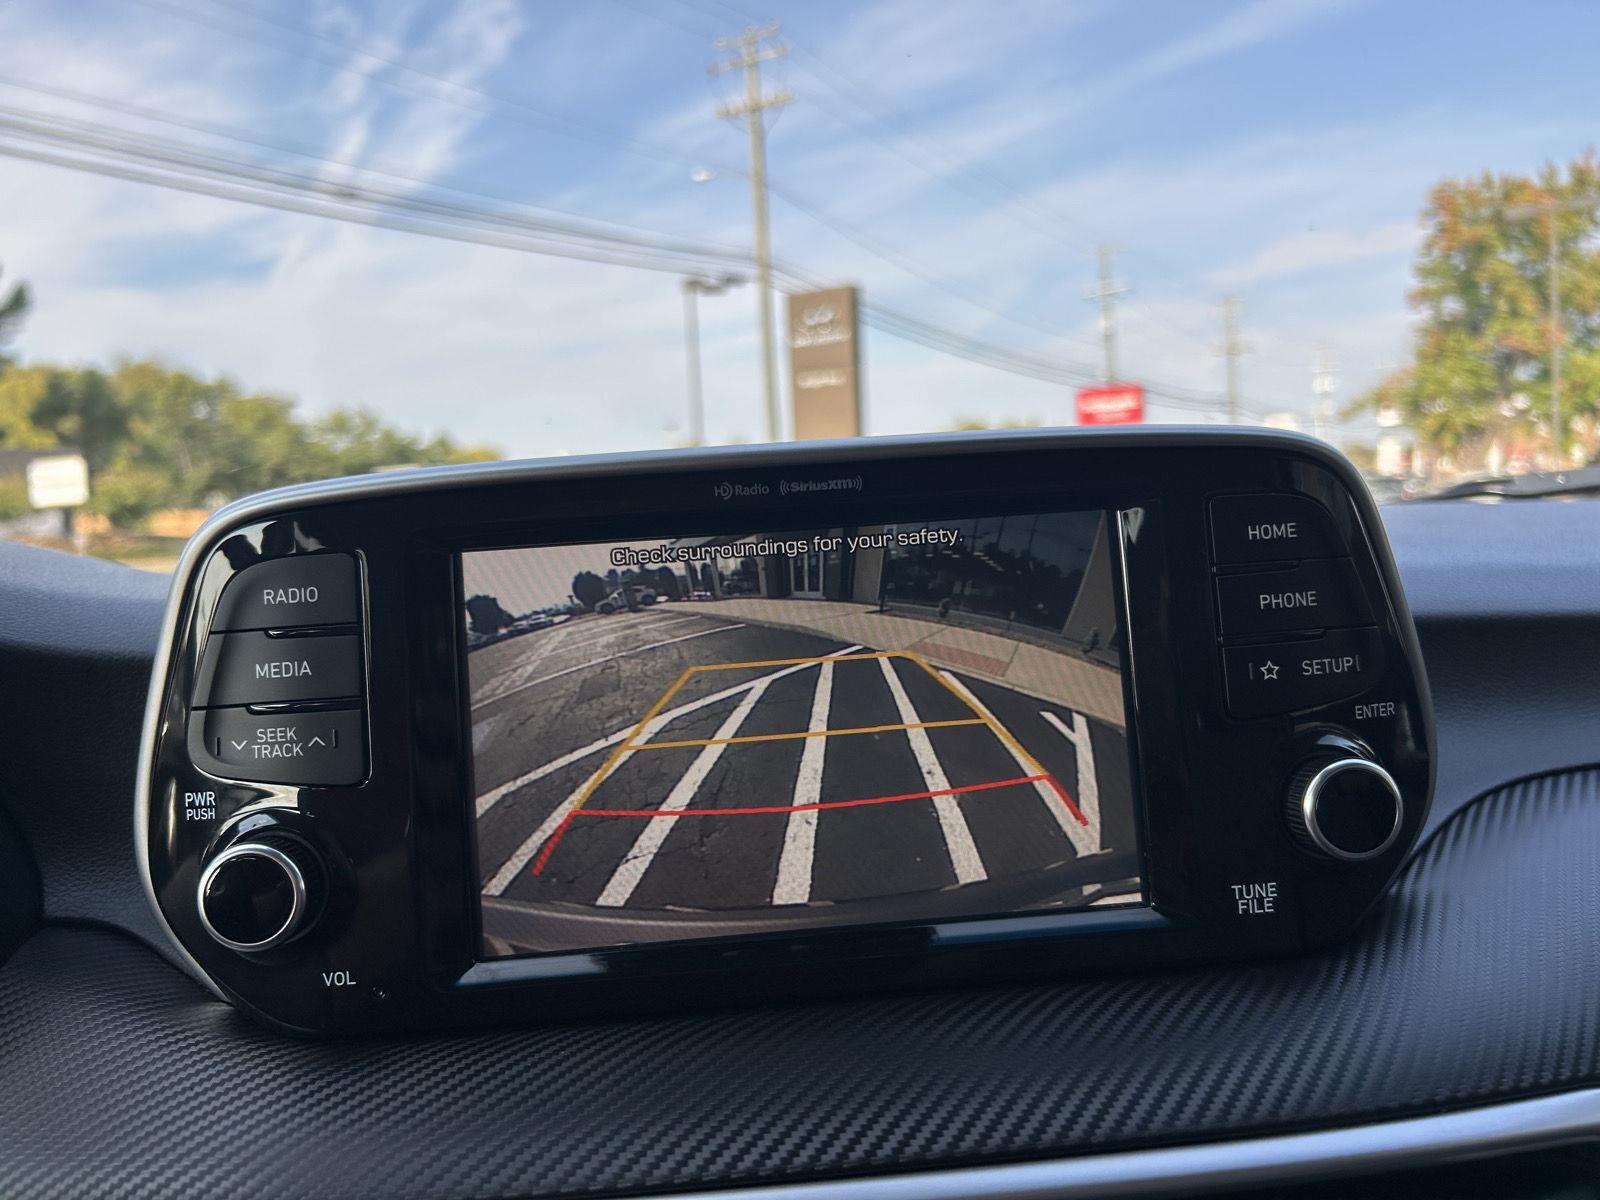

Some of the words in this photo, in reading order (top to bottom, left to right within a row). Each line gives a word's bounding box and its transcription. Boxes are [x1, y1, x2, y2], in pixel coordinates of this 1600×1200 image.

[735, 483, 770, 497] Radio
[1247, 522, 1298, 541] HOME
[611, 545, 674, 565] Check
[678, 538, 808, 560] surroundings
[813, 536, 842, 552] for
[847, 533, 893, 553] your
[898, 528, 963, 546] safety.
[263, 586, 319, 605] RADIO
[1259, 590, 1318, 610] PHONE
[255, 660, 312, 679] MEDIA
[1301, 656, 1353, 676] SETUP
[1354, 701, 1395, 719] ENTER
[256, 727, 298, 743] SEEK
[252, 742, 304, 759] TRACK
[184, 791, 216, 807] PWR
[186, 807, 216, 821] PUSH
[1231, 882, 1277, 900] TUNE
[1238, 897, 1274, 915] FILE
[322, 971, 357, 987] VOL
